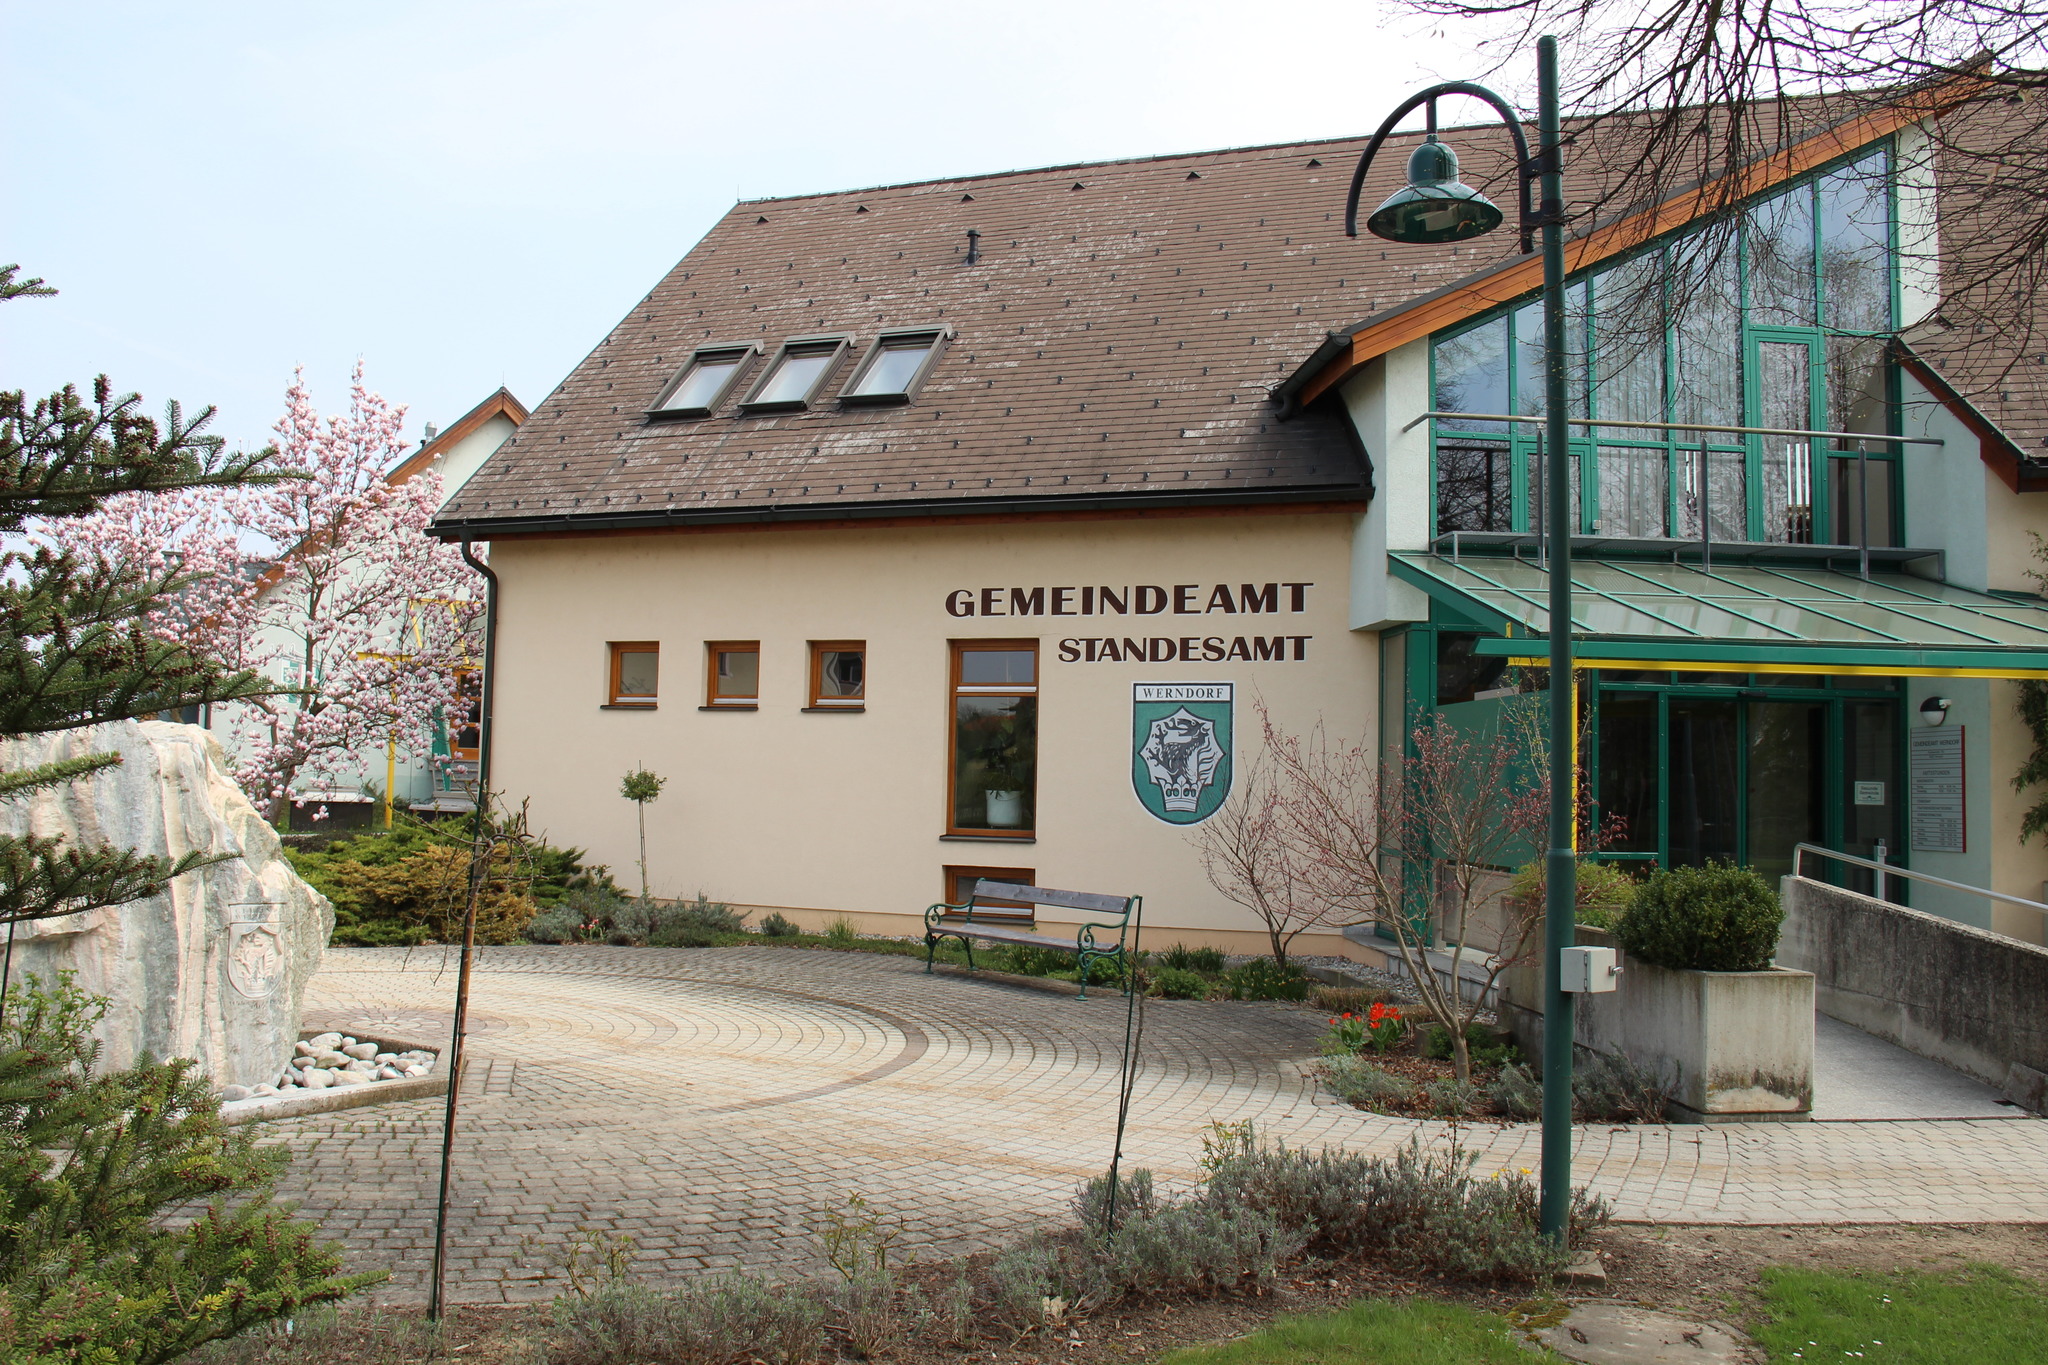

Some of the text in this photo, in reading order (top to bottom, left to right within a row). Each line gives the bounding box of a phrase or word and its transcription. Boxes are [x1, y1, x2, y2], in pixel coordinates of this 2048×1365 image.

[945, 583, 1314, 617] GEMEINDEAMT
[1058, 635, 1313, 663] STANDESAMT
[1142, 687, 1224, 699] WERNDORF
